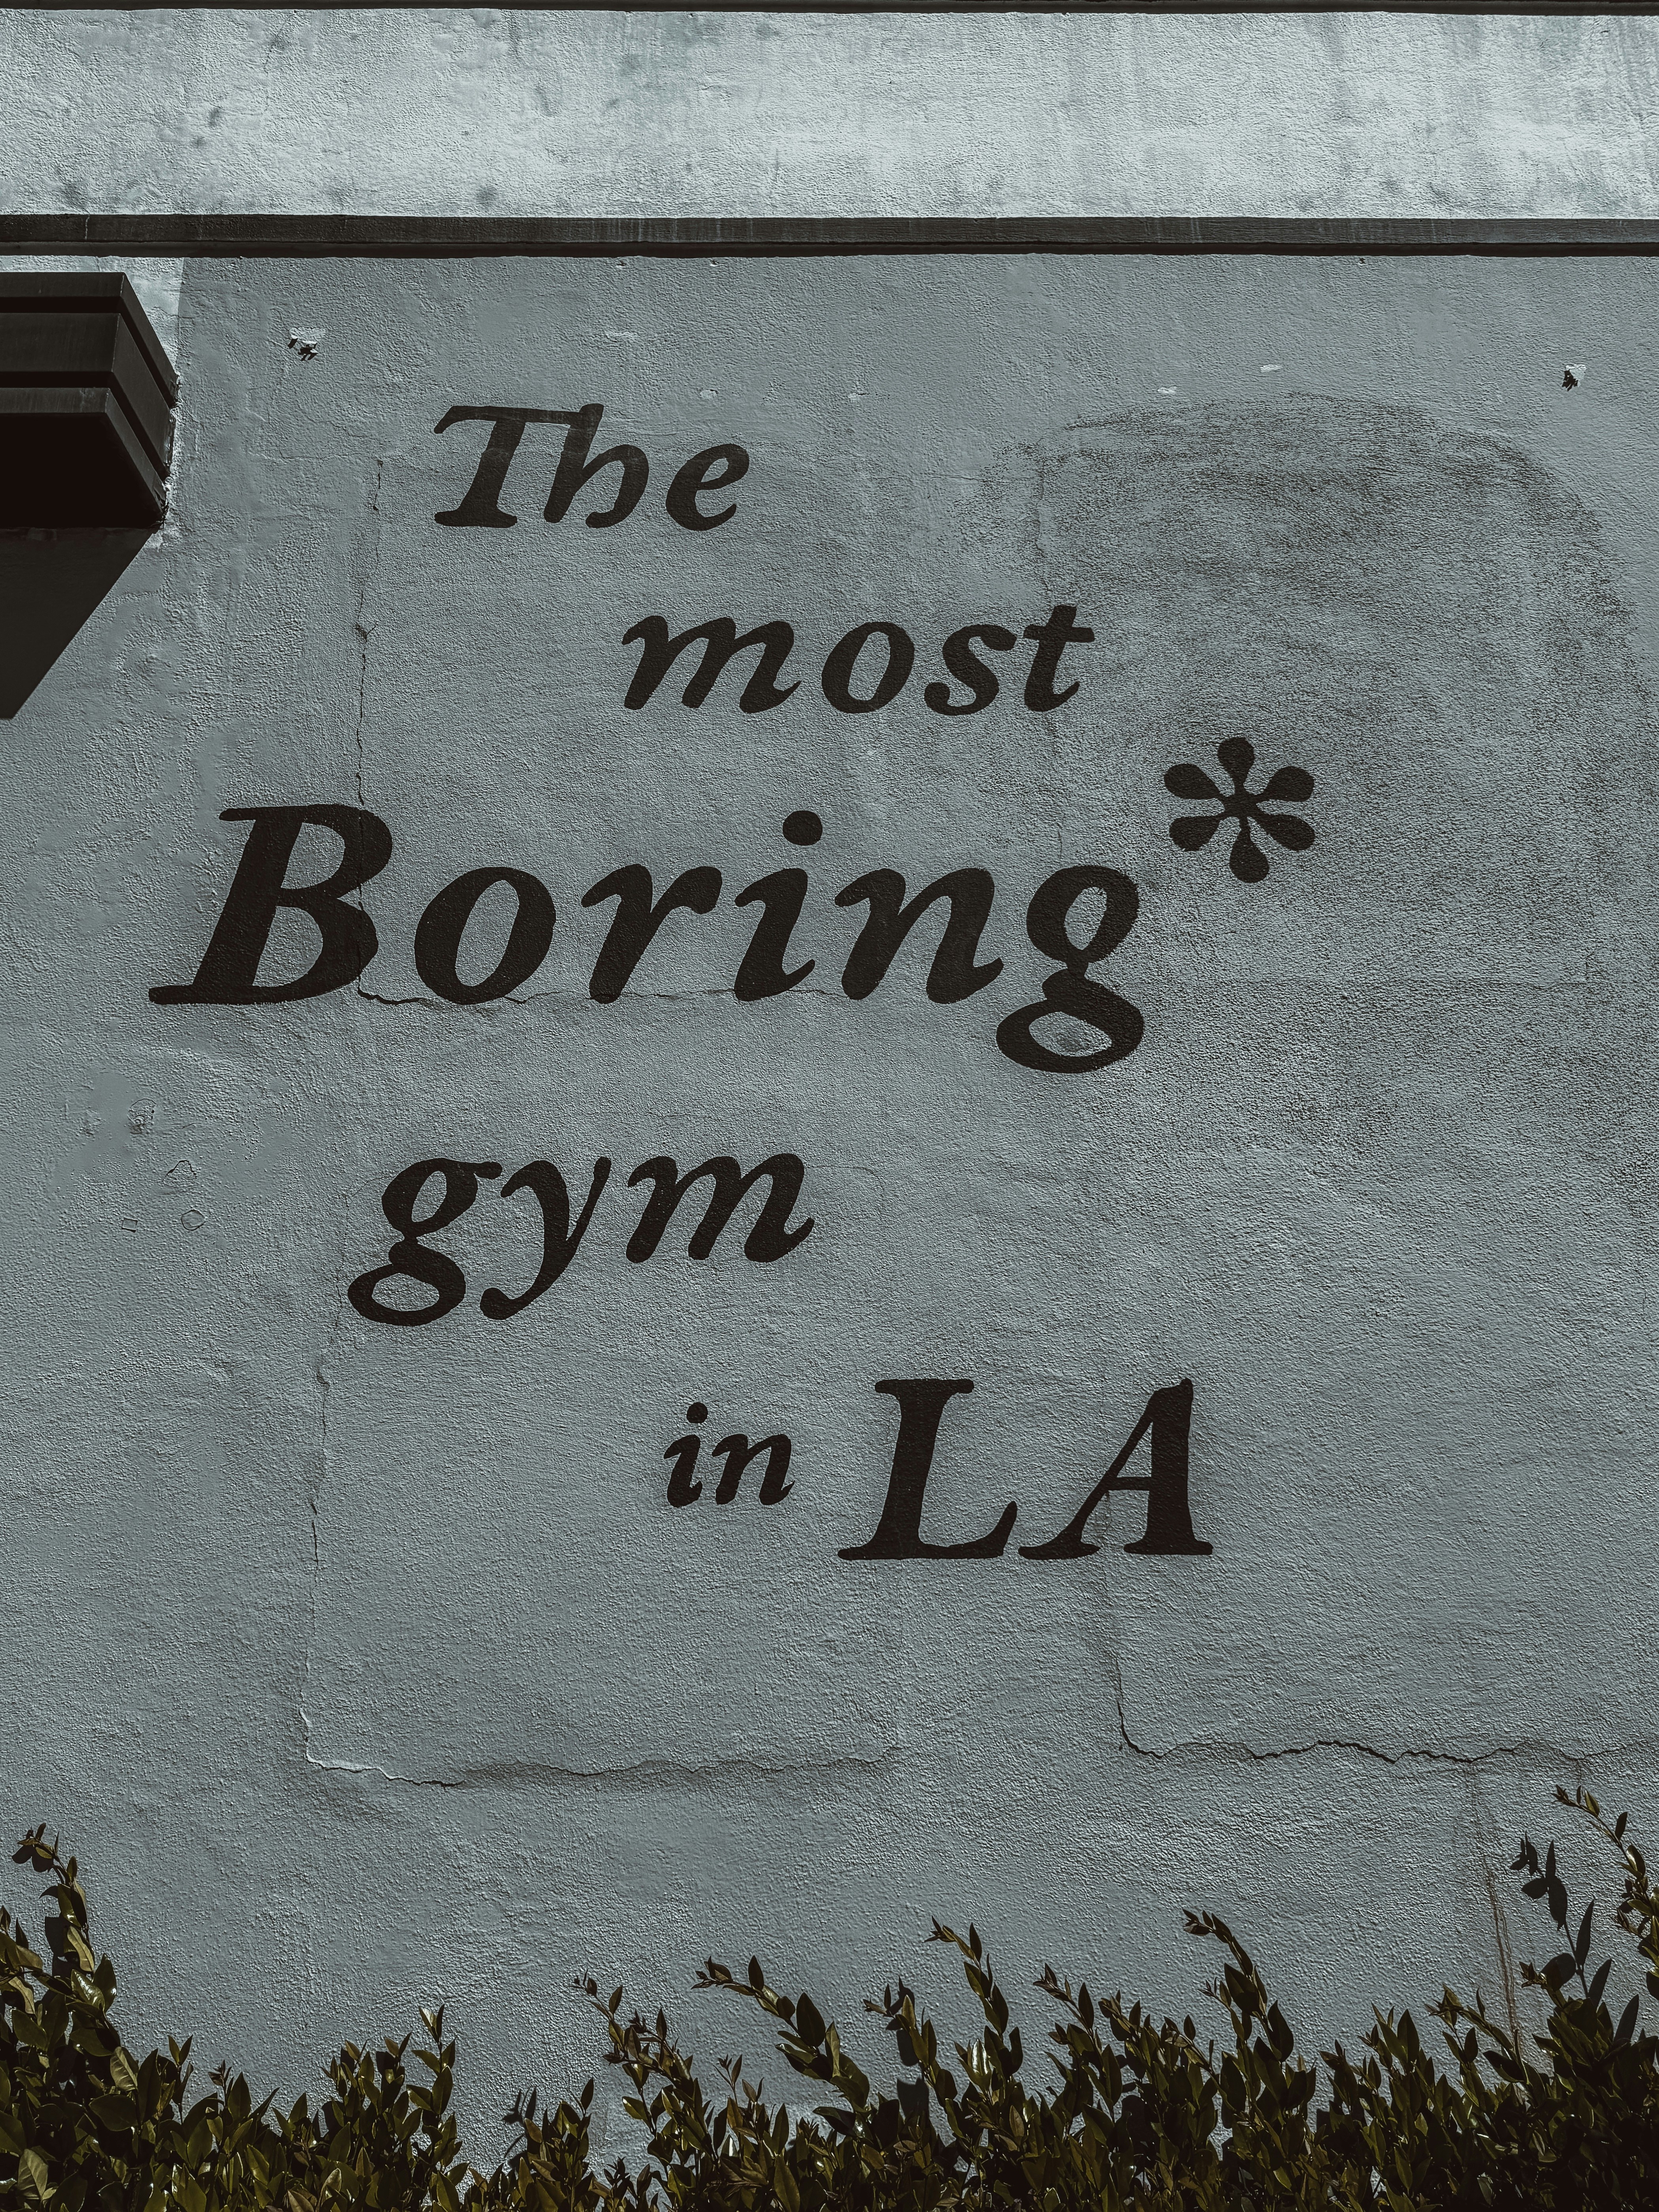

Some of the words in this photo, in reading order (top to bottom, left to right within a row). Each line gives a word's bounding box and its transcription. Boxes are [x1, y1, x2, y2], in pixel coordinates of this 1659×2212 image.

[433, 402, 750, 532] The
[621, 604, 1096, 716] most
[346, 1153, 815, 1328] gym
[663, 1402, 795, 1508] in
[837, 1378, 1214, 1561] LA
